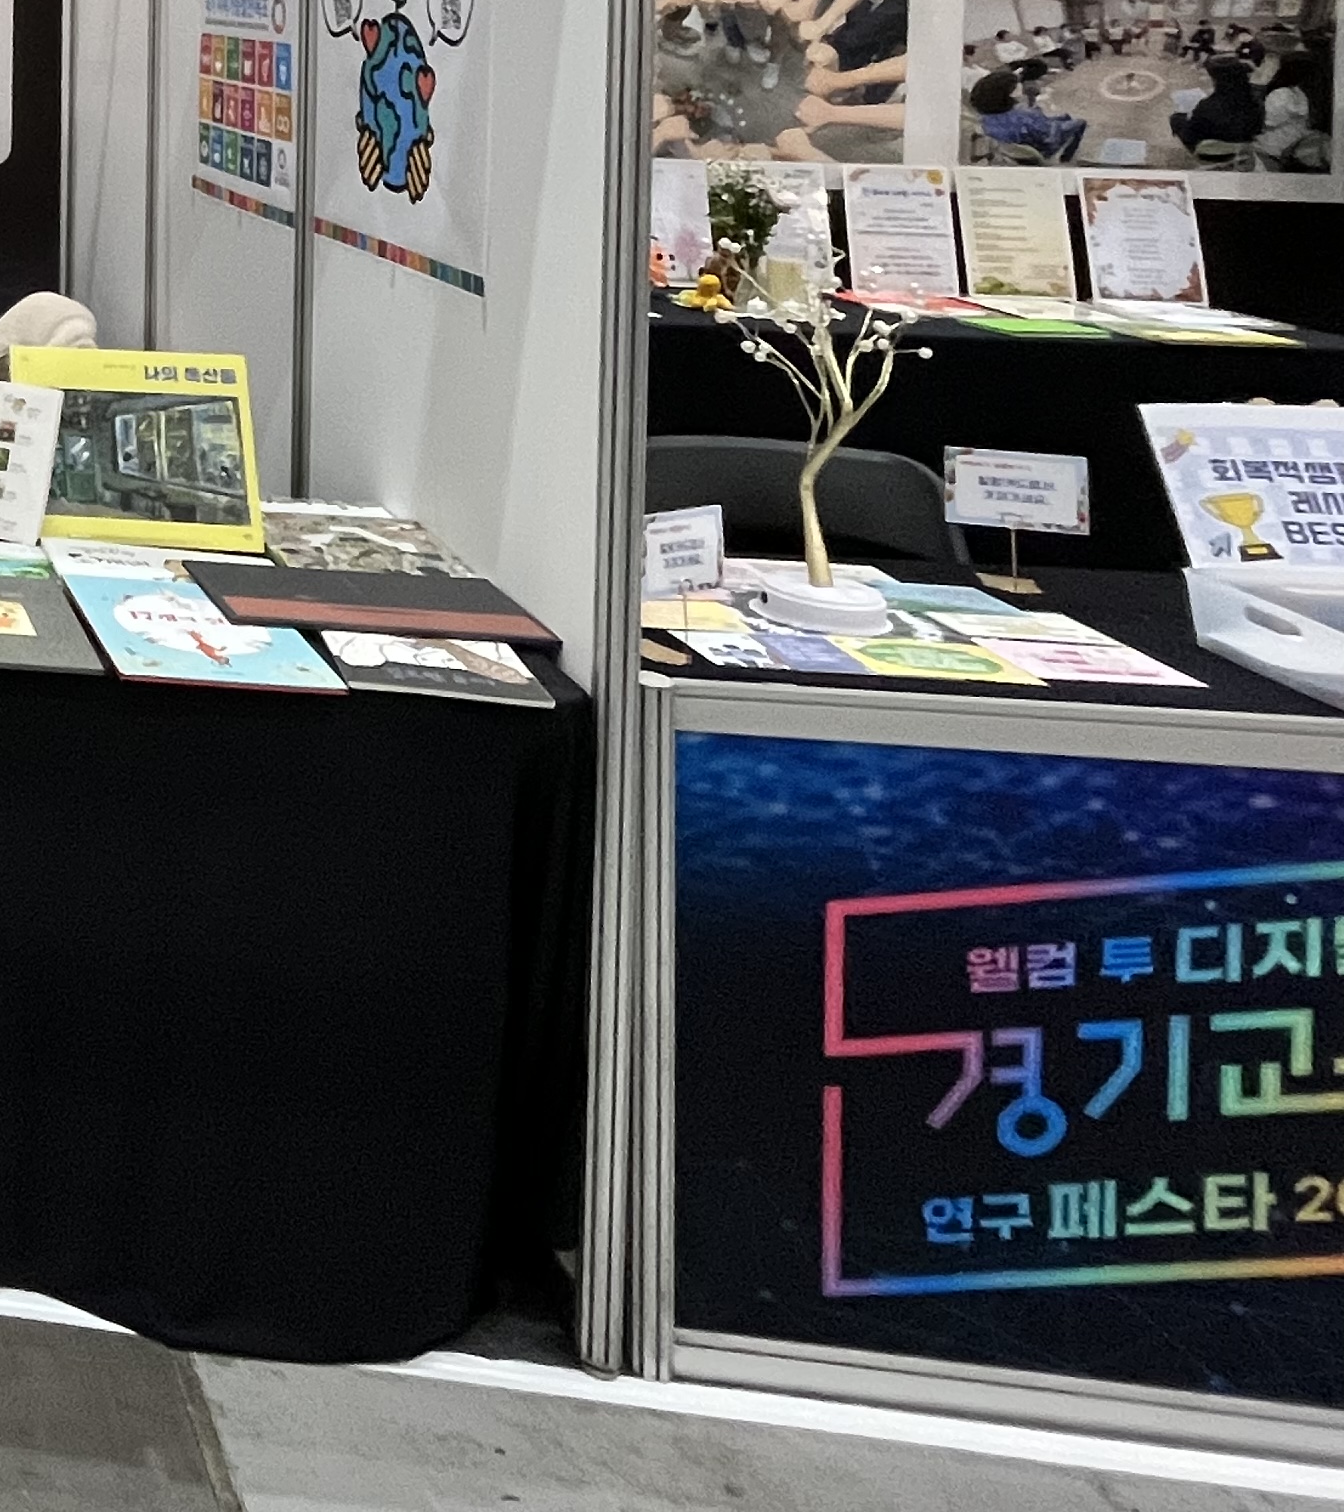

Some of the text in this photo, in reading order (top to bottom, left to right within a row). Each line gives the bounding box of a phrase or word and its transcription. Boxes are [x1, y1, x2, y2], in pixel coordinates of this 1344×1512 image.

[144, 365, 178, 382] 나의
[966, 916, 1344, 993] 웰컴 투 디지
[926, 1008, 1344, 1157] 경기교
[922, 1192, 1033, 1243] 연구
[1048, 1172, 1277, 1240] 페스타
